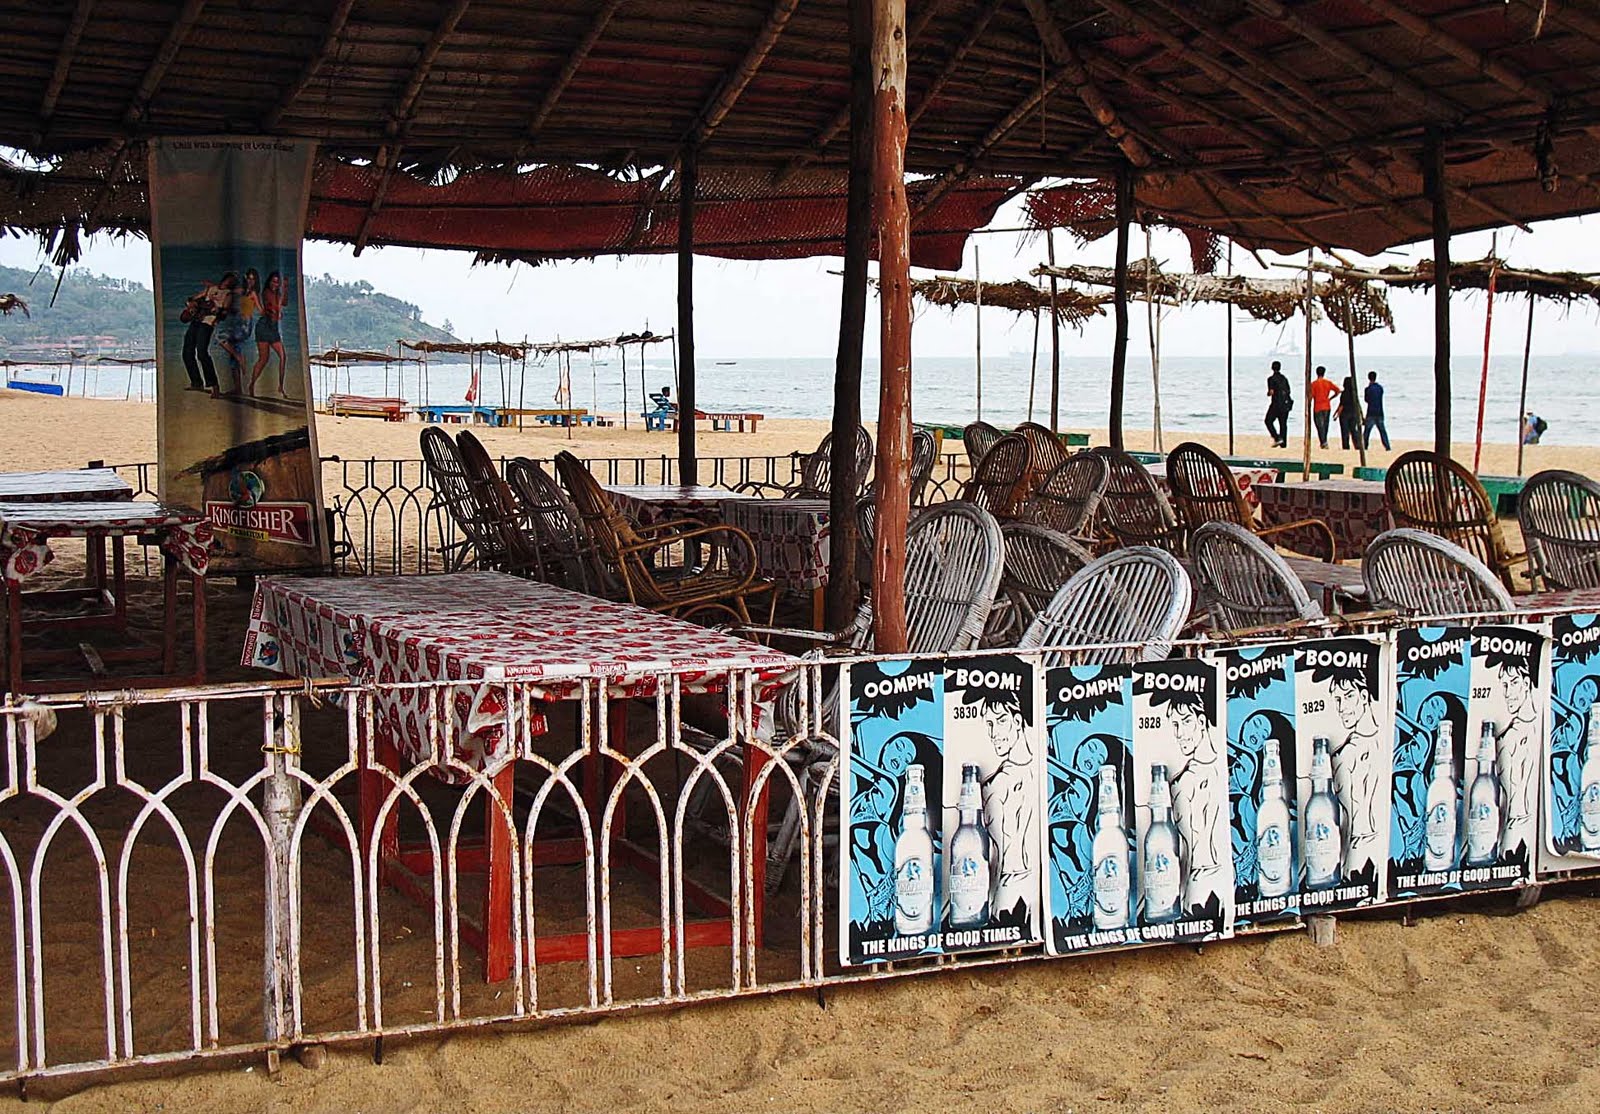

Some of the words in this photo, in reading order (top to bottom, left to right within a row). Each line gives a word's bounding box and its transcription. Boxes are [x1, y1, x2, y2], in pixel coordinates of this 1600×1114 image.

[212, 506, 303, 540] KINGFISHER
[1407, 638, 1465, 662] OOMPH!
[1480, 635, 1532, 657] BOOM!
[1227, 653, 1287, 681] OOMPH!
[1306, 649, 1368, 669] BOOM!
[864, 672, 935, 698] OOMPH!
[956, 668, 1022, 691] BOOM!
[1058, 675, 1124, 702] OOMPH!
[1143, 672, 1206, 693] BOOM!
[1472, 687, 1491, 699] 3827
[953, 706, 978, 720] 3830
[1302, 699, 1325, 715] 3829
[1138, 716, 1161, 730] 3828
[1396, 875, 1416, 889] THE
[1417, 870, 1448, 886] KINGS
[1449, 870, 1462, 884] OF
[1463, 867, 1490, 883] GOOD
[1492, 865, 1522, 880] TIMES
[1253, 896, 1286, 914] KINGS
[1287, 894, 1302, 908] OF
[1303, 890, 1334, 906] GOOD
[1336, 885, 1369, 901] TIMES
[861, 941, 886, 955] THE
[887, 936, 926, 952] KINGS
[926, 935, 944, 949] OF
[945, 931, 981, 947] GOOD
[983, 926, 1021, 942] TIMES
[1064, 935, 1089, 950] THE
[1089, 931, 1126, 947] KINGS
[1127, 928, 1141, 941] OF
[1142, 924, 1176, 940] GOOD
[1178, 920, 1214, 936] TIMES
